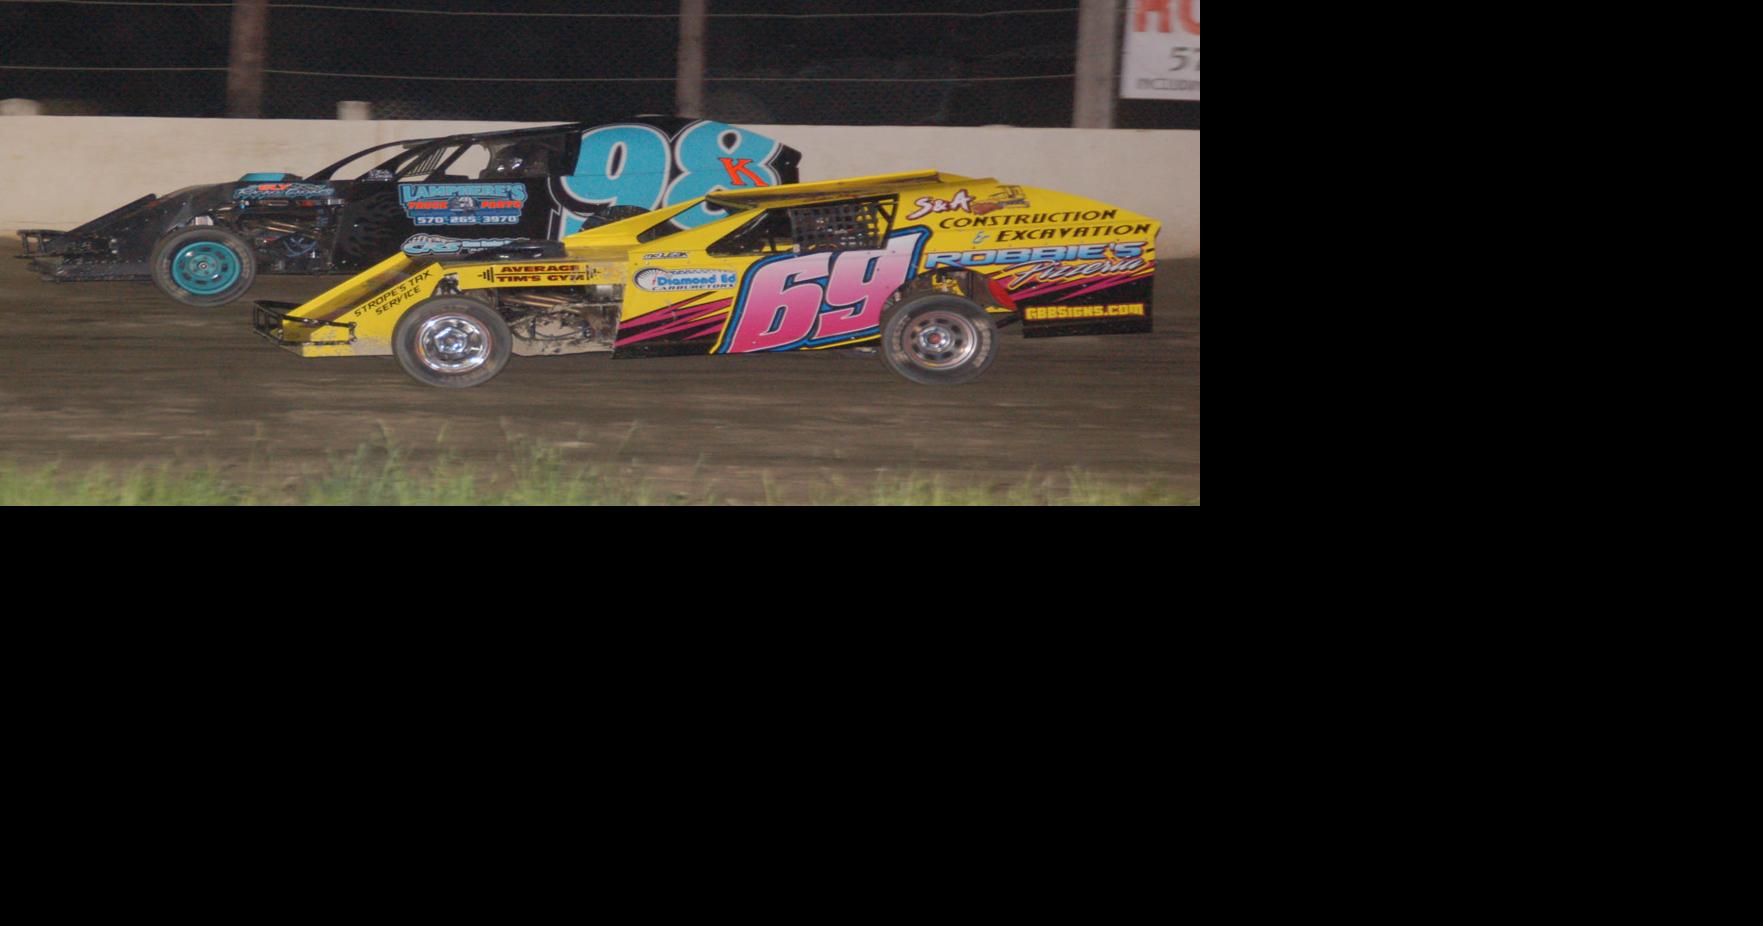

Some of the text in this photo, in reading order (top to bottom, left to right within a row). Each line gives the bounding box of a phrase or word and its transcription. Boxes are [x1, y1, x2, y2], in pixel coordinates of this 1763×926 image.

[718, 156, 769, 187] K
[400, 183, 527, 203] LAMPHERE'S
[939, 209, 1118, 229] CONSTRUCTION
[995, 223, 1152, 243] EXCAVATION
[924, 242, 1148, 269] ROBBIE'S
[408, 270, 432, 287] TAX
[656, 273, 736, 286] Diamond Ed
[1003, 257, 1145, 290] Pizzeria
[376, 285, 421, 315] SERVICE
[728, 233, 923, 354] 69
